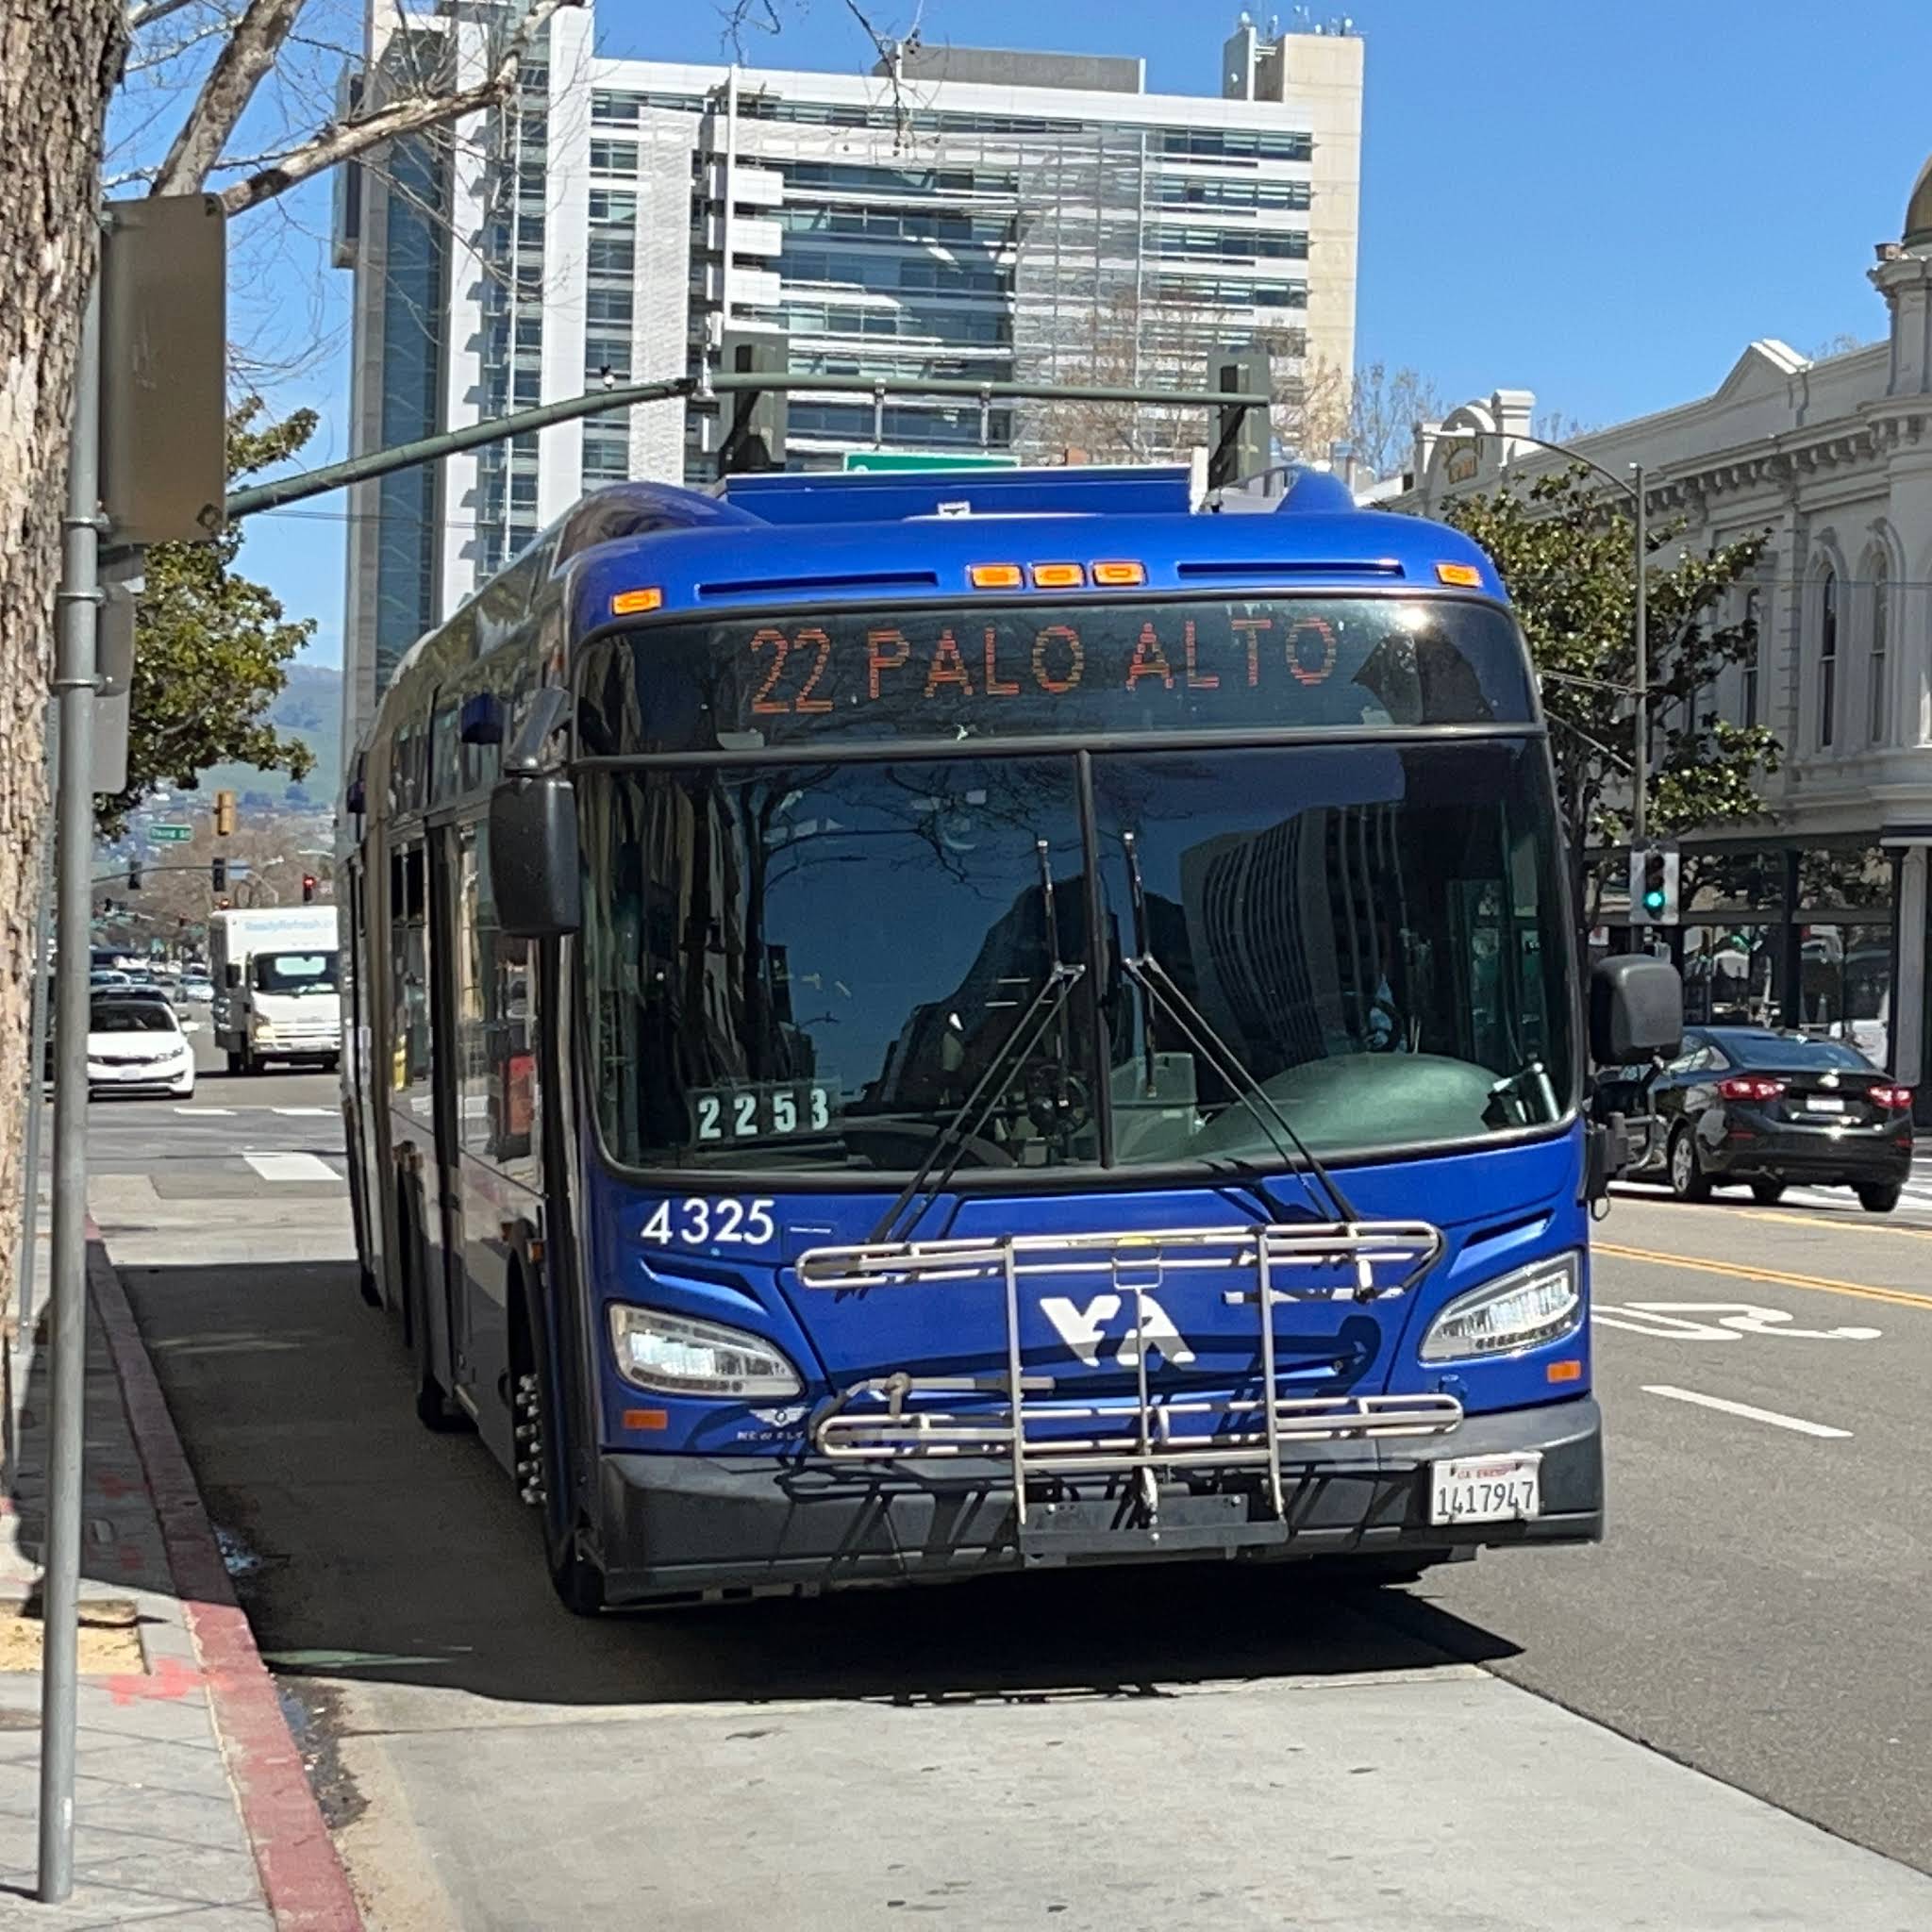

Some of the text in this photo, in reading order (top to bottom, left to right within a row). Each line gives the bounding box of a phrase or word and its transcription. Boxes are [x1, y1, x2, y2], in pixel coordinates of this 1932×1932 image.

[750, 616, 1337, 713] 22 PALO ALTO
[698, 1088, 829, 1140] 2253
[641, 1198, 774, 1244] 4325
[776, 1431, 804, 1441] FLY
[1438, 1481, 1534, 1516] 1417947
